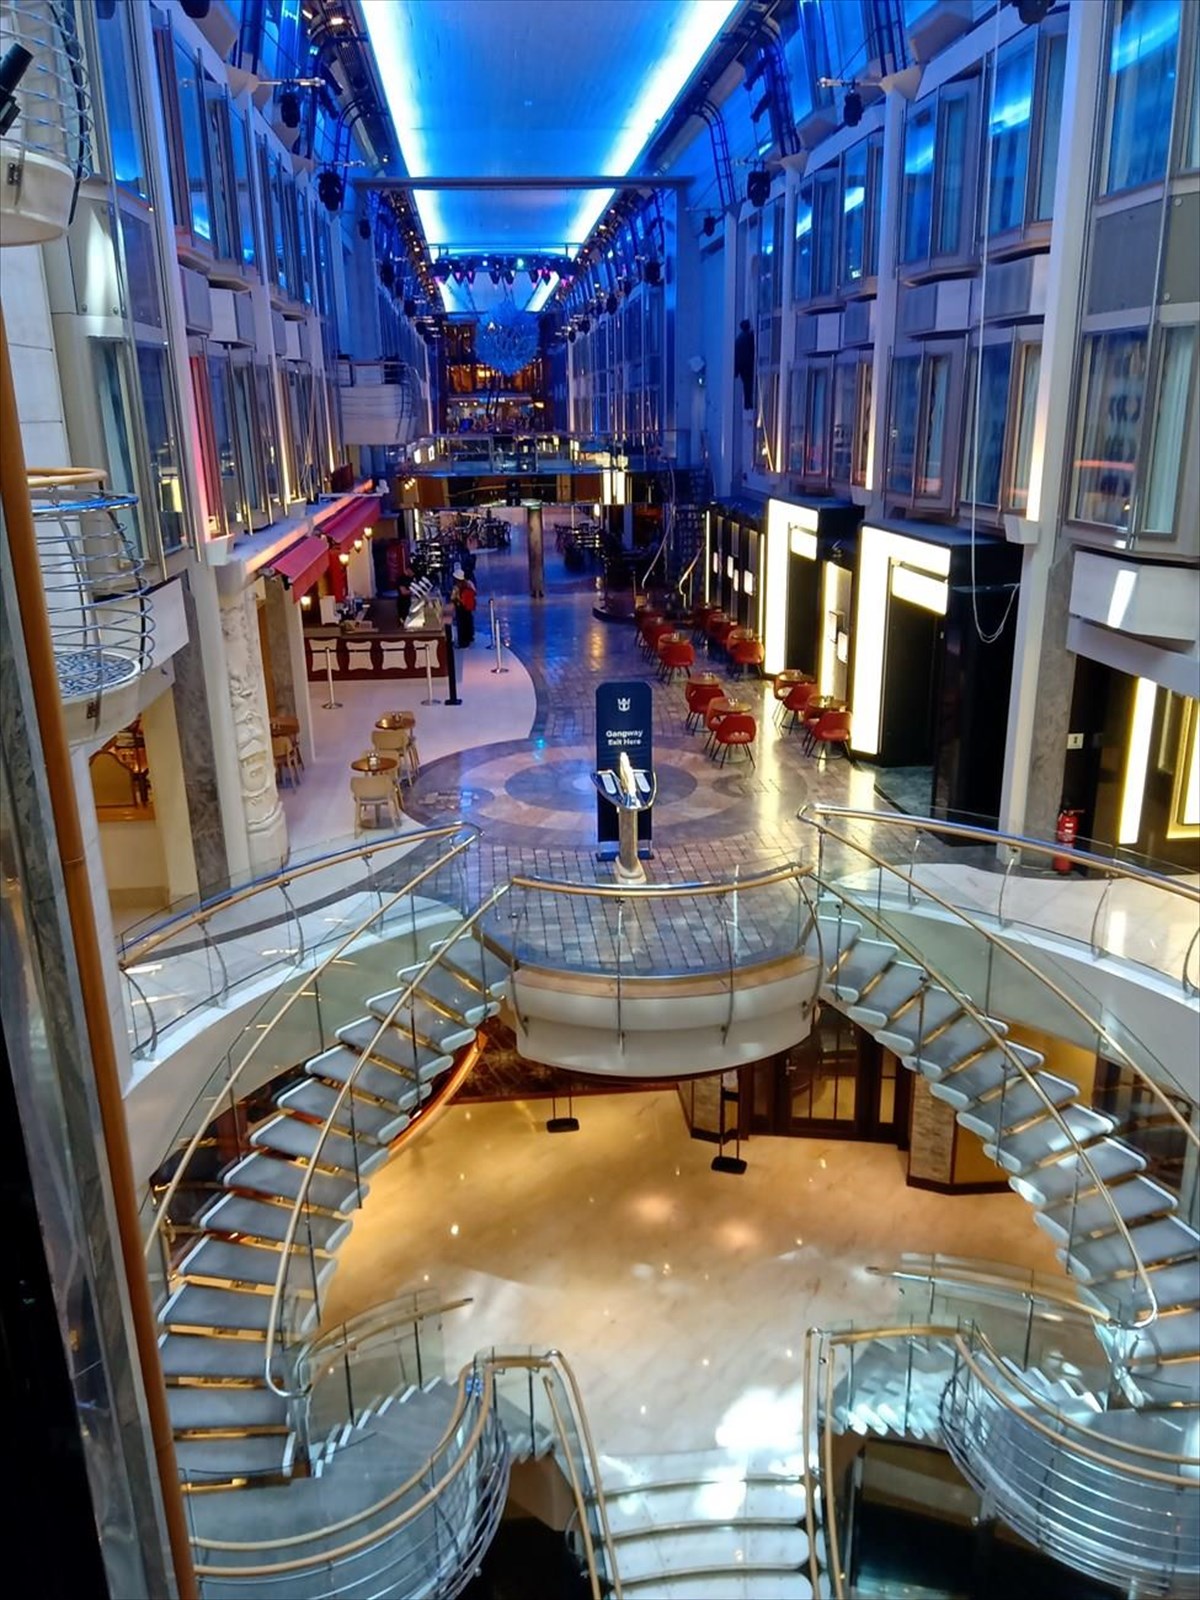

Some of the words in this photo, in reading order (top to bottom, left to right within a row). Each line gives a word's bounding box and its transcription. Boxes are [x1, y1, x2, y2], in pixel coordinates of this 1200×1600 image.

[605, 729, 644, 739] Gangway
[607, 738, 622, 746] Exit
[623, 738, 642, 746] Here
